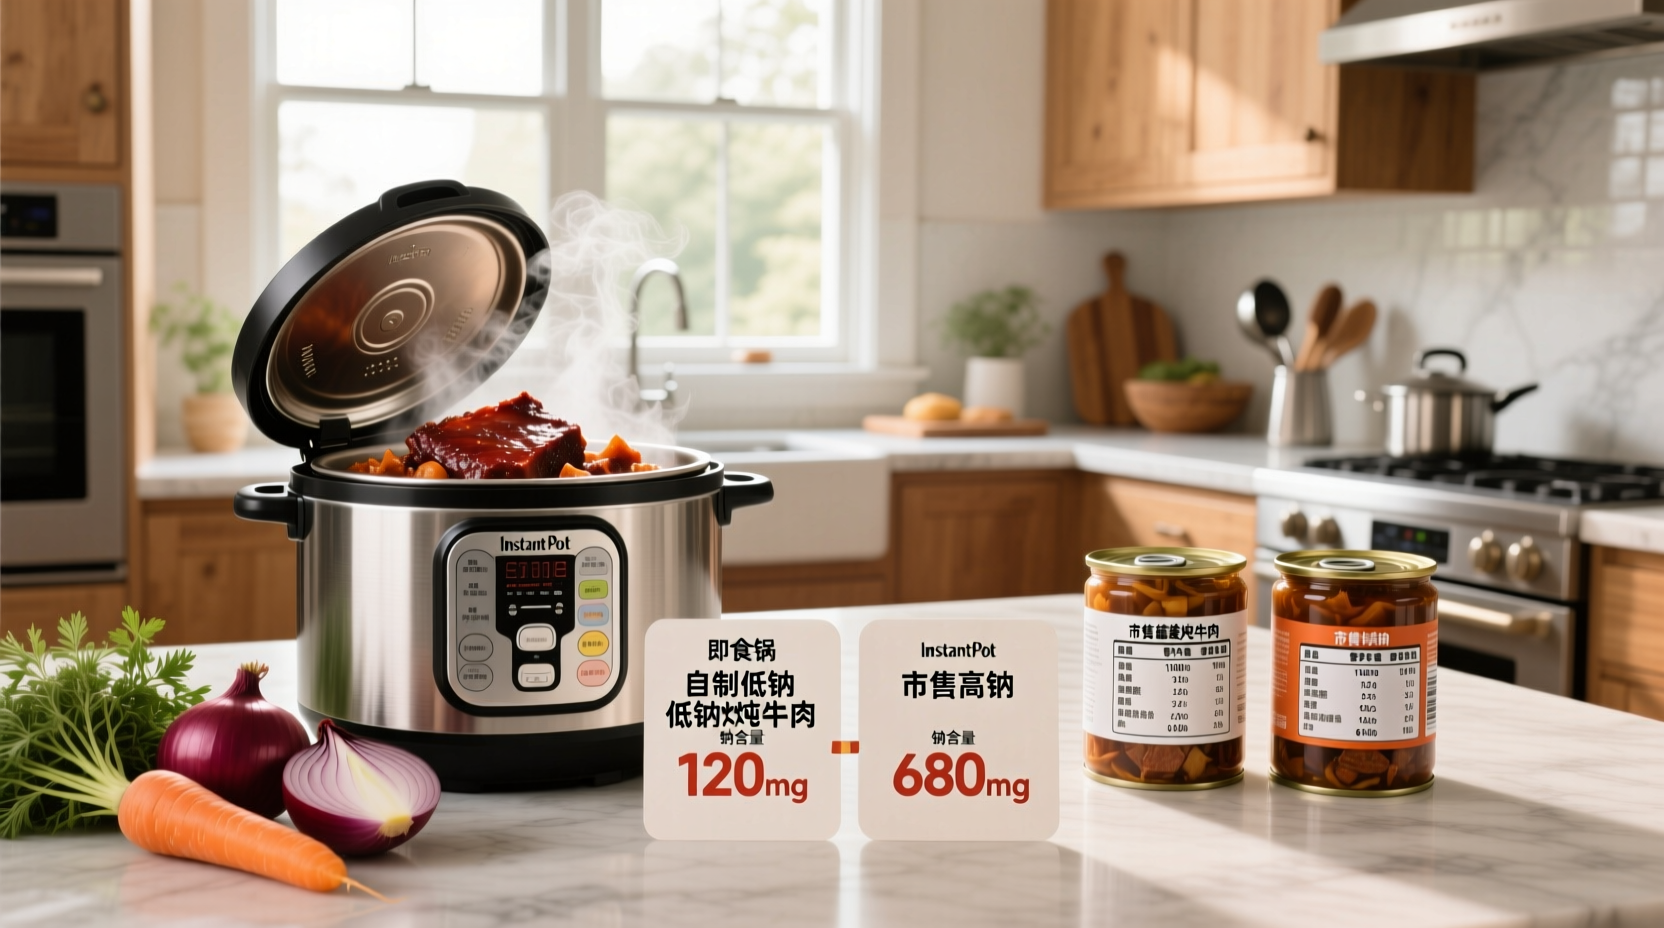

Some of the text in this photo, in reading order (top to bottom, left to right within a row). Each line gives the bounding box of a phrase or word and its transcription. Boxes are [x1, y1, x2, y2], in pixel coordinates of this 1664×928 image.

[500, 535, 571, 552] Instant Pot
[708, 637, 776, 662] 即食锅
[686, 670, 795, 698] 自制低钠
[901, 670, 1014, 699] 市售高钠
[931, 730, 976, 745] 钠含量
[678, 752, 808, 804] 120mg
[893, 752, 1030, 804] 680mg
